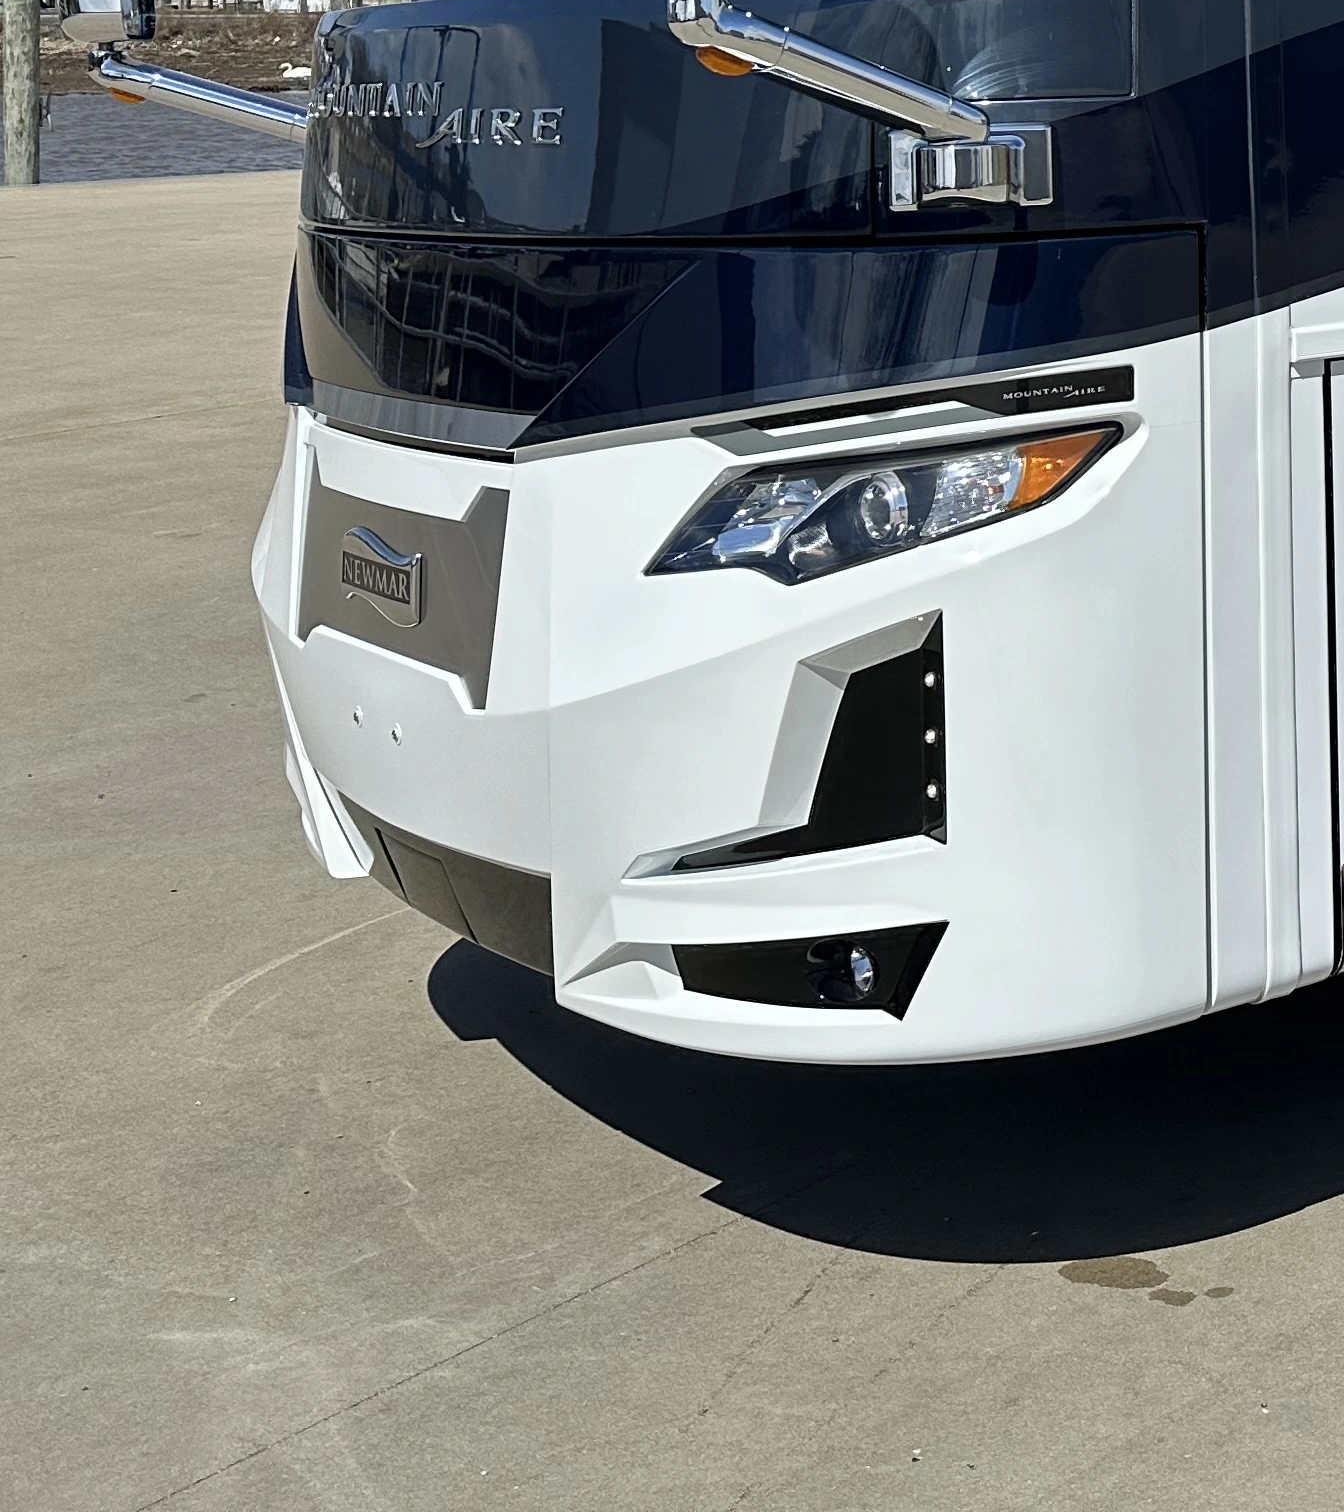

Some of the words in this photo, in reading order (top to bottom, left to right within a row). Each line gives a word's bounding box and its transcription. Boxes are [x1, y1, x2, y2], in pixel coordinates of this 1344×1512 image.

[416, 105, 565, 149] AIRE
[1002, 384, 1074, 401] MOUNTAIN
[1063, 384, 1106, 399] AIRE
[343, 556, 411, 602] NEWMAR
